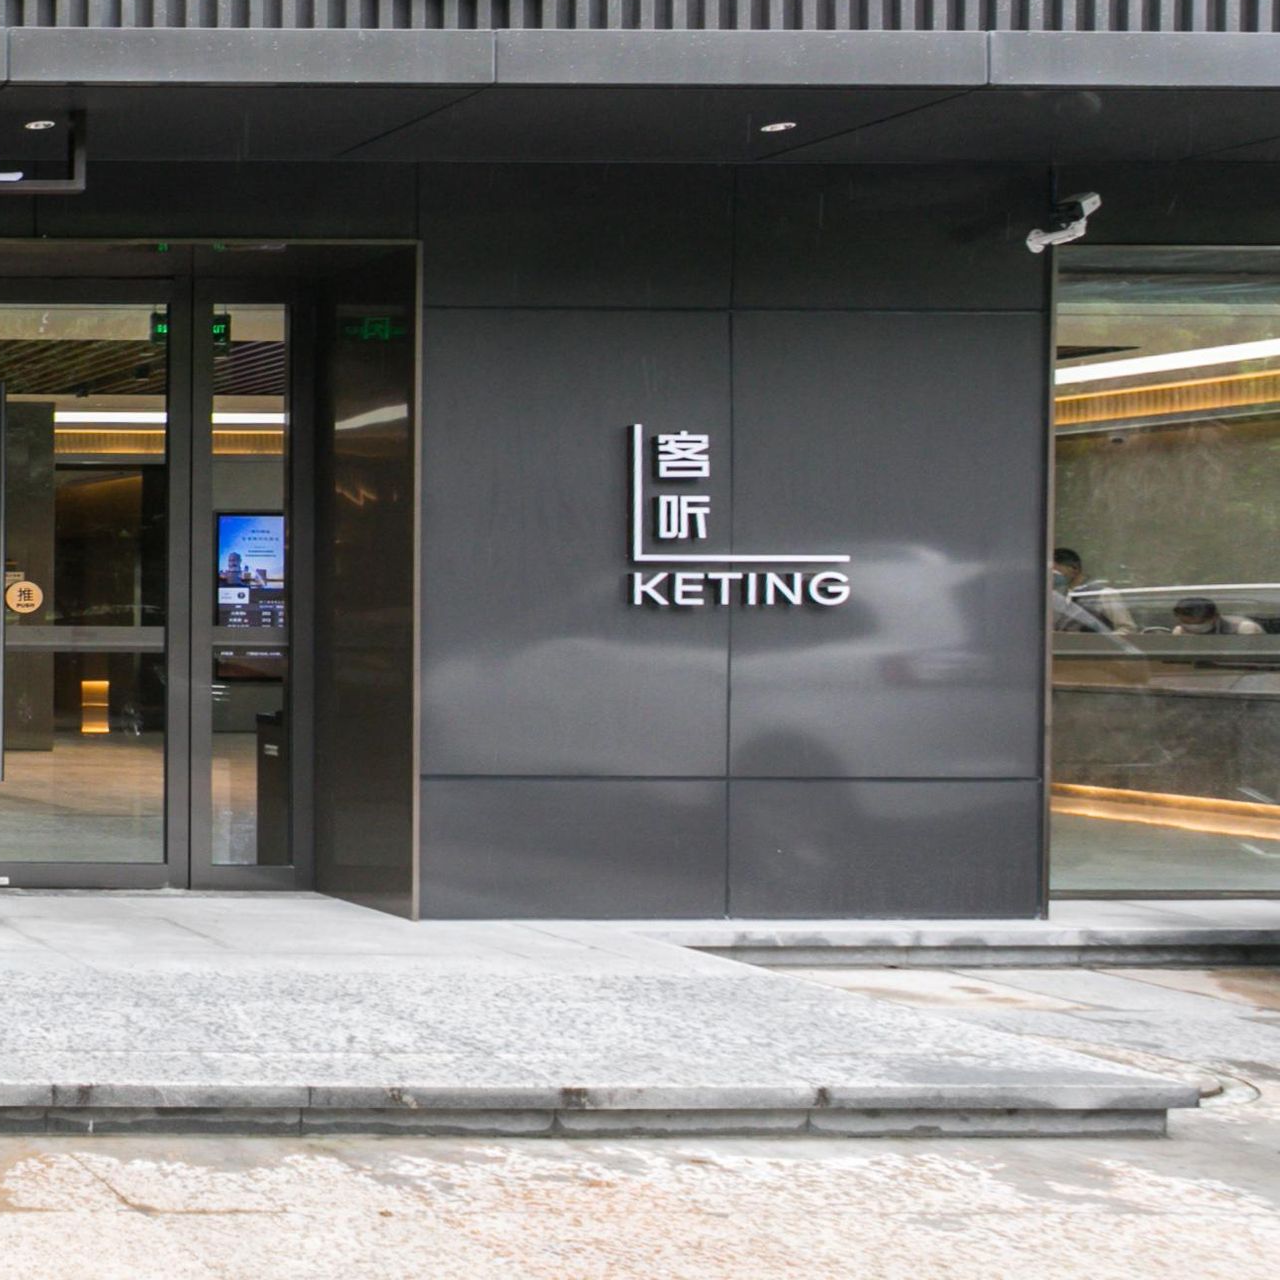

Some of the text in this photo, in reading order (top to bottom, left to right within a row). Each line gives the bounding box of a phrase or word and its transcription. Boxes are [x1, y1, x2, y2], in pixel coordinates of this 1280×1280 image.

[657, 430, 711, 539] 客听
[17, 587, 34, 601] 推
[633, 571, 851, 606] KETING
